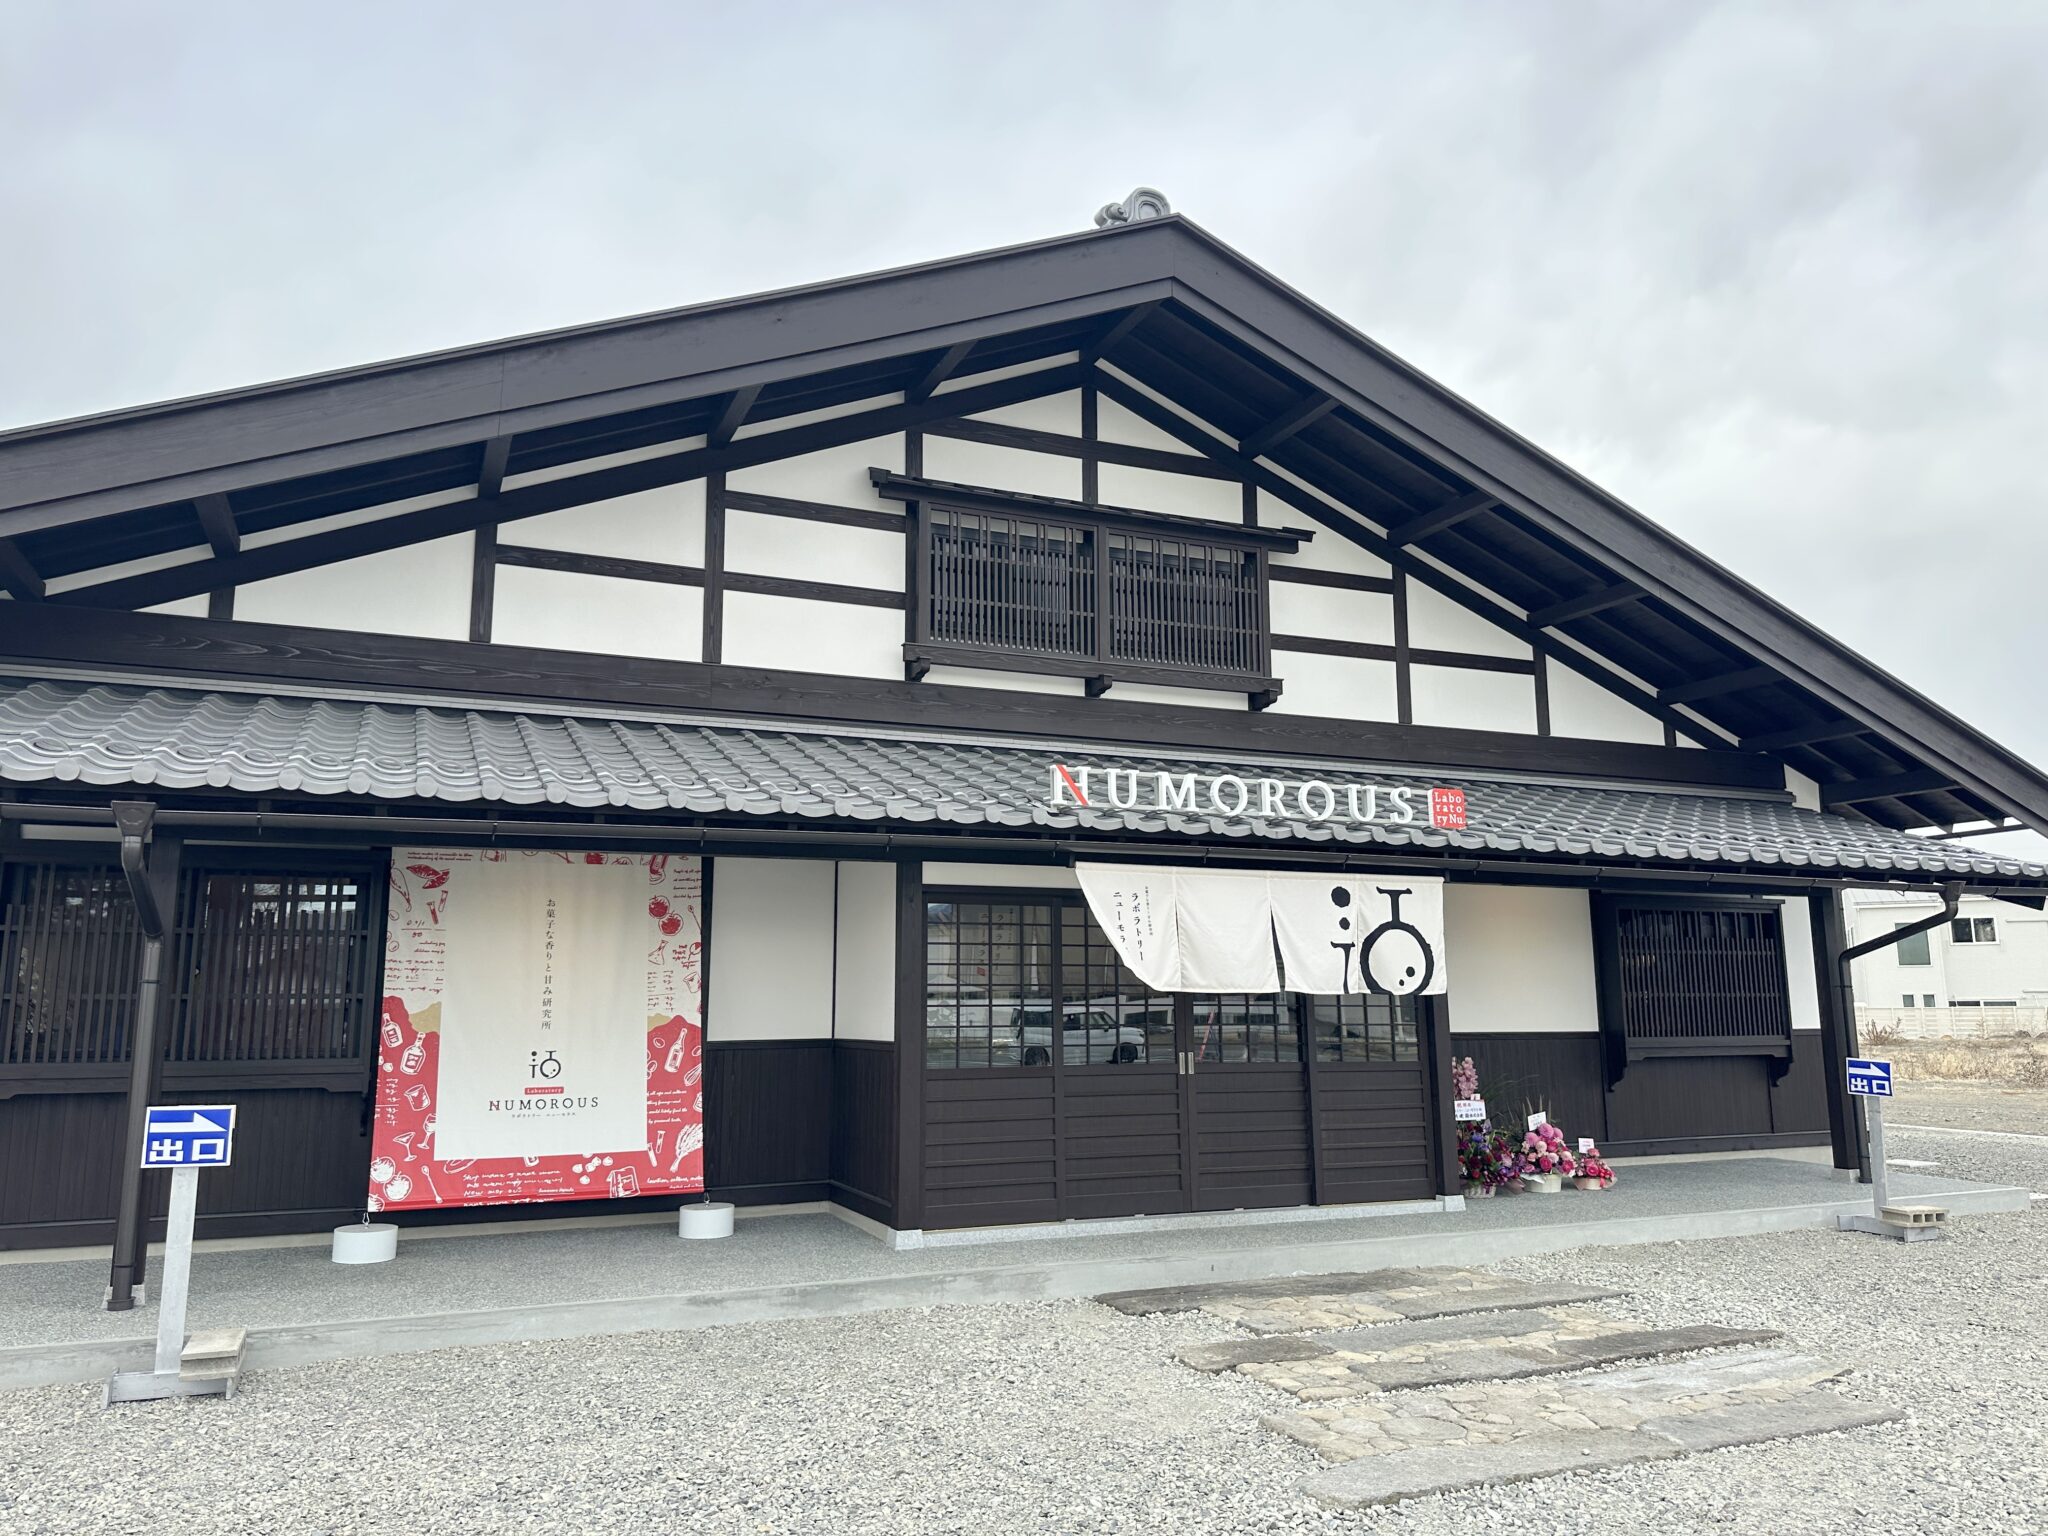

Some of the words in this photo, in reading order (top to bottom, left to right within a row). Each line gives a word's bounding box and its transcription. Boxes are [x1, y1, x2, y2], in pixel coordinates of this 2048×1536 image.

[1050, 764, 1414, 824] NUMOROUS
[1434, 791, 1462, 803] Labo
[1436, 804, 1463, 813] rato
[1113, 891, 1130, 952] ニューモラ
[1131, 892, 1144, 961] ラボラトリー
[541, 899, 557, 1030] お菓子な香りと甘み研究所
[526, 1087, 563, 1096] Laboratory
[1850, 1077, 1891, 1095] 出口
[489, 1096, 600, 1112] NUMOROUS
[148, 1138, 225, 1162] 出口
